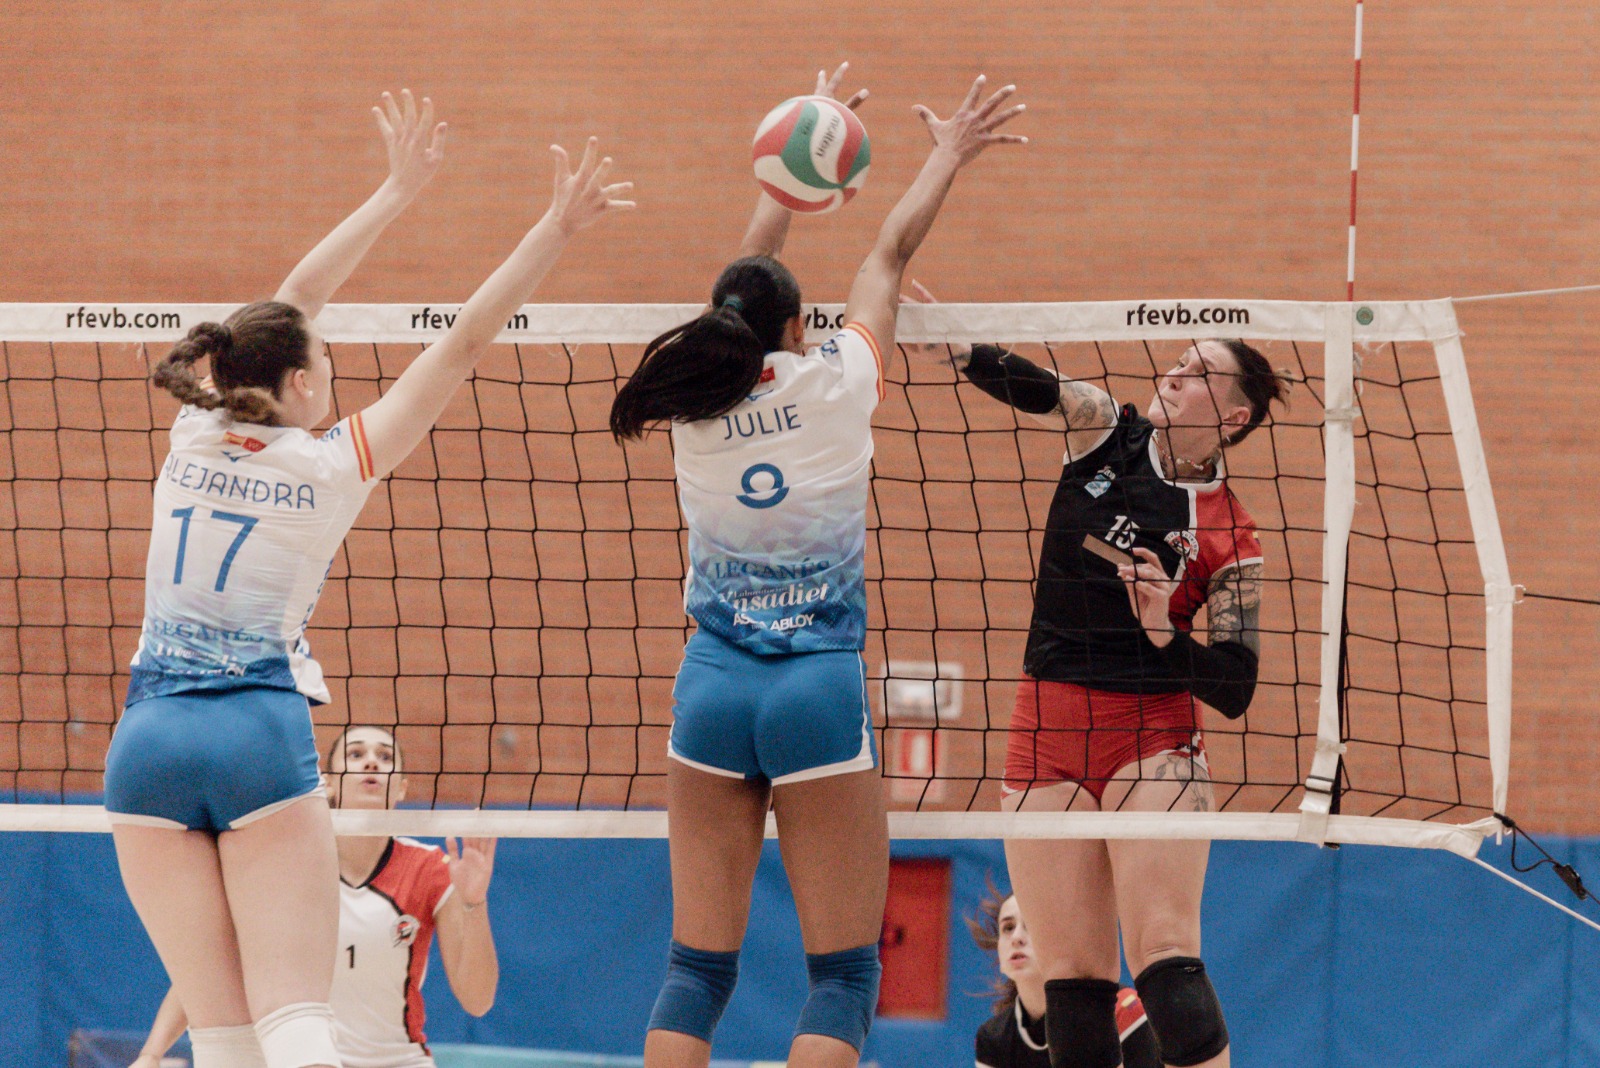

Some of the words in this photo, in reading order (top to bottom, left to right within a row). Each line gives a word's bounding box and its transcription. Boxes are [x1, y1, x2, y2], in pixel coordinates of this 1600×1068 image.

[66, 306, 180, 328] rfevb.com
[411, 307, 528, 329] rfevm
[1126, 302, 1250, 326] rfevb.com
[721, 404, 801, 440] JULIE
[1104, 515, 1140, 549] 15
[171, 505, 260, 593] 17
[770, 613, 815, 632] ABLOY
[345, 944, 355, 969] 1
